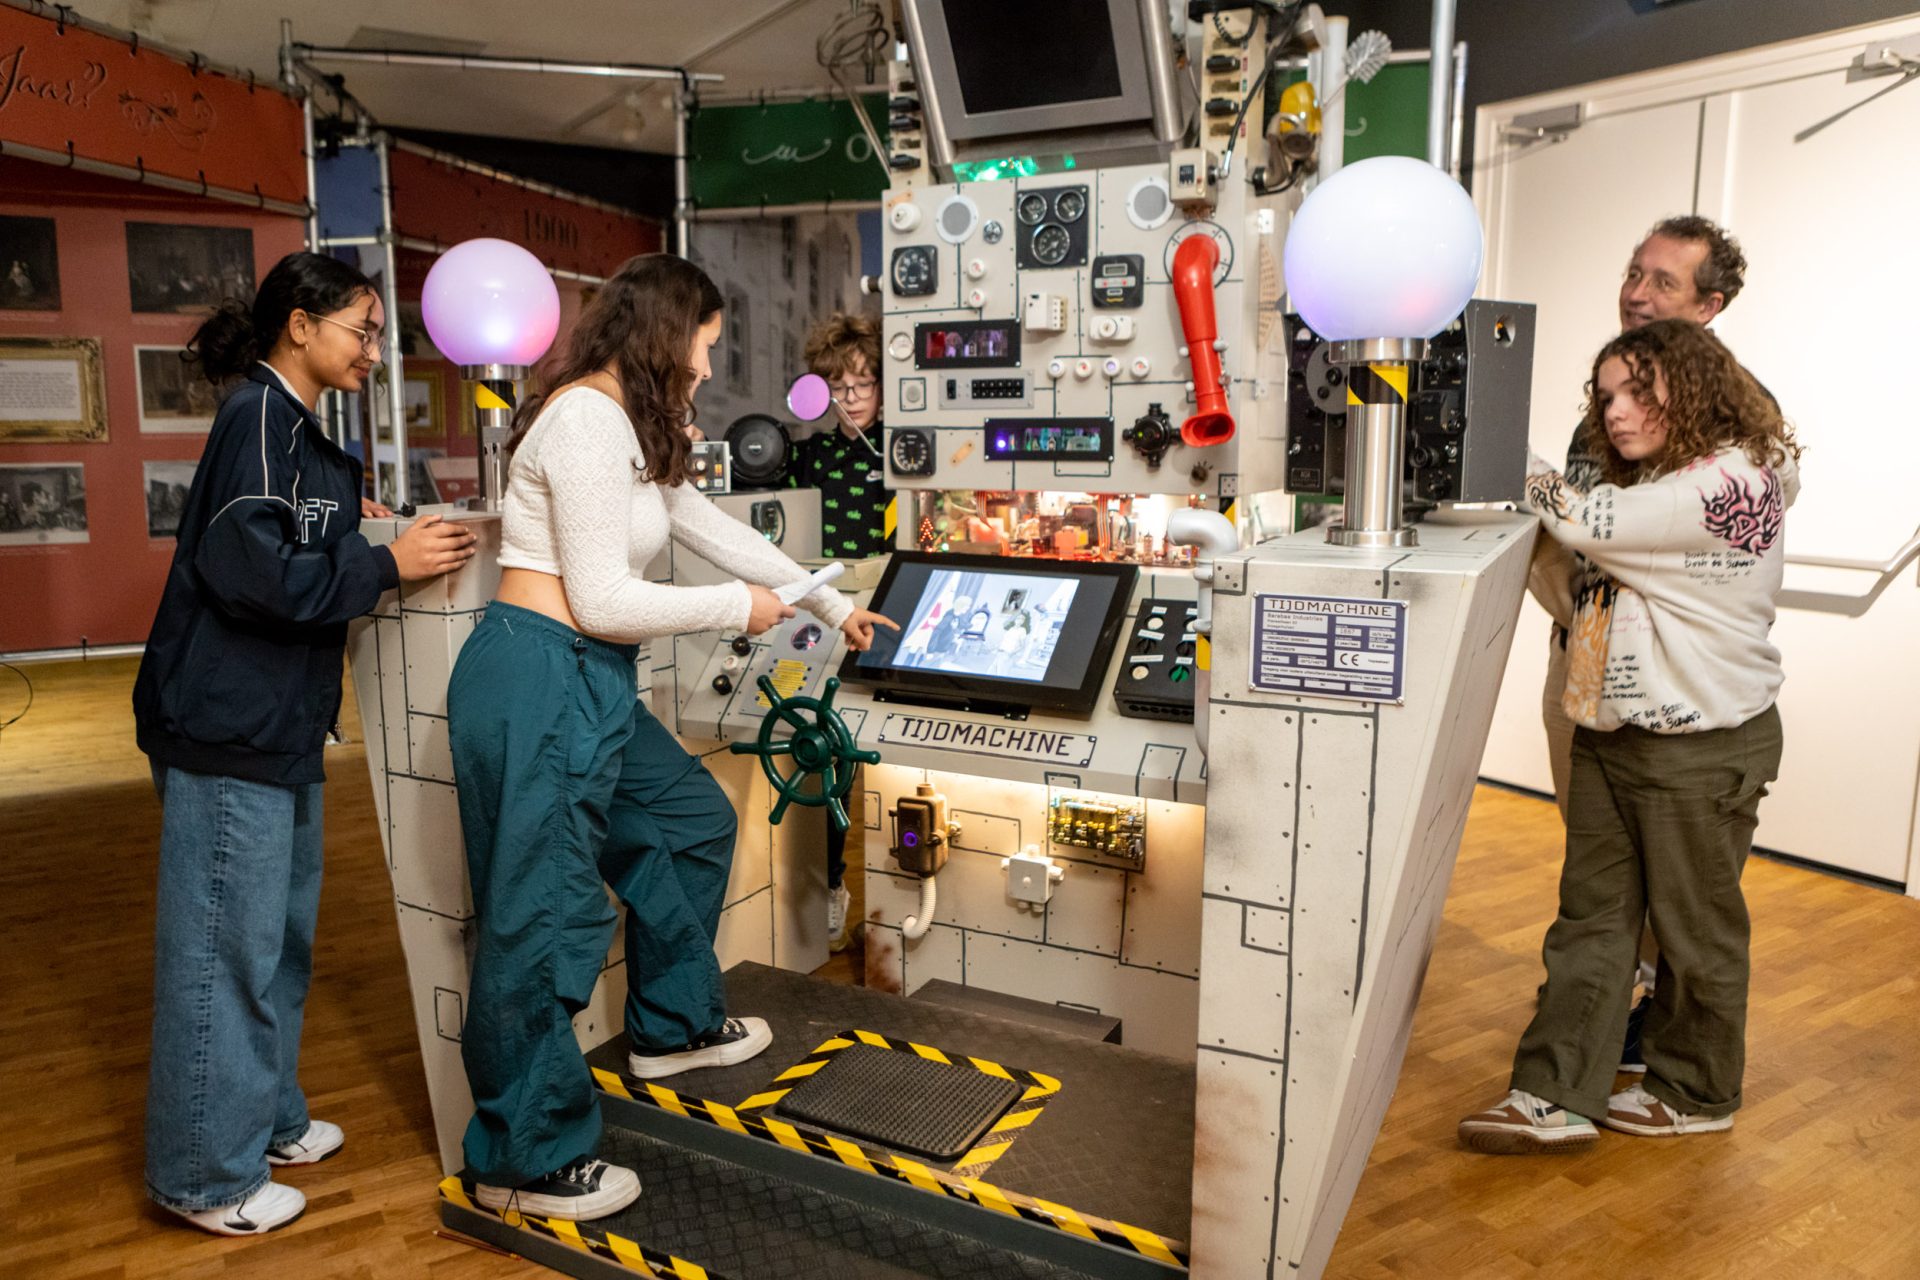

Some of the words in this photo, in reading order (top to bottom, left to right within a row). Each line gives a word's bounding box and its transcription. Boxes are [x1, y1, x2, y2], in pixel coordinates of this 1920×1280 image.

[1268, 599, 1393, 617] TIJDMACHINE
[1340, 653, 1360, 667] CE
[900, 717, 1075, 757] TIJDMACHINE
